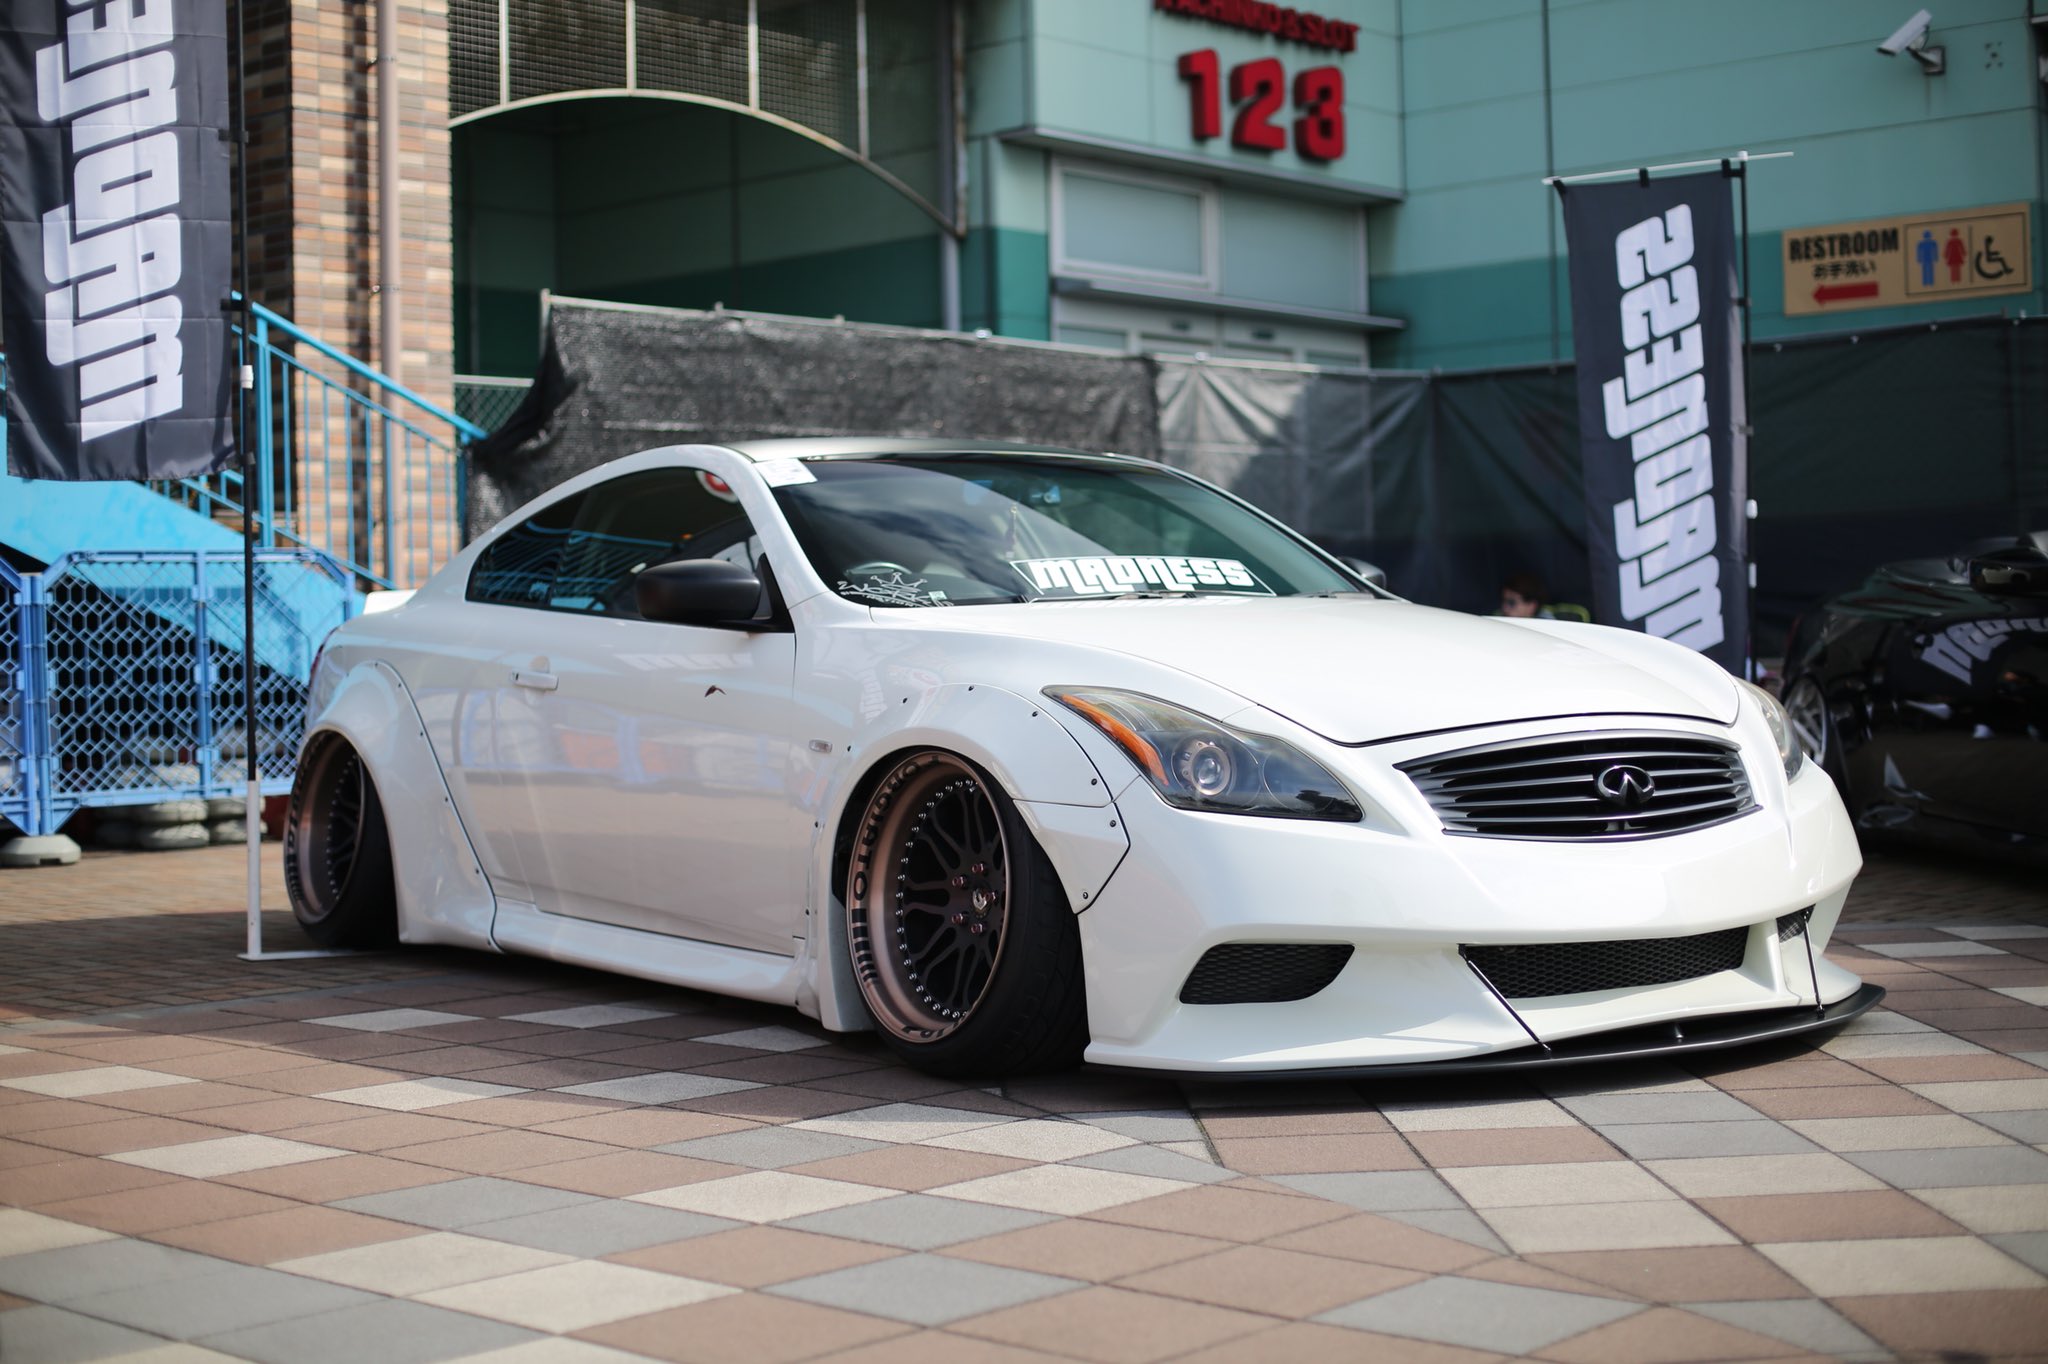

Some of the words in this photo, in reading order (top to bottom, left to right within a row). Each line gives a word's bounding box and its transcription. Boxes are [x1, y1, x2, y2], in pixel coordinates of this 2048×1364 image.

[1177, 48, 1345, 161] 123
[1789, 227, 1899, 262] RESTROOM
[1812, 260, 1877, 280] お手洗い
[1028, 557, 1255, 594] MADNESS
